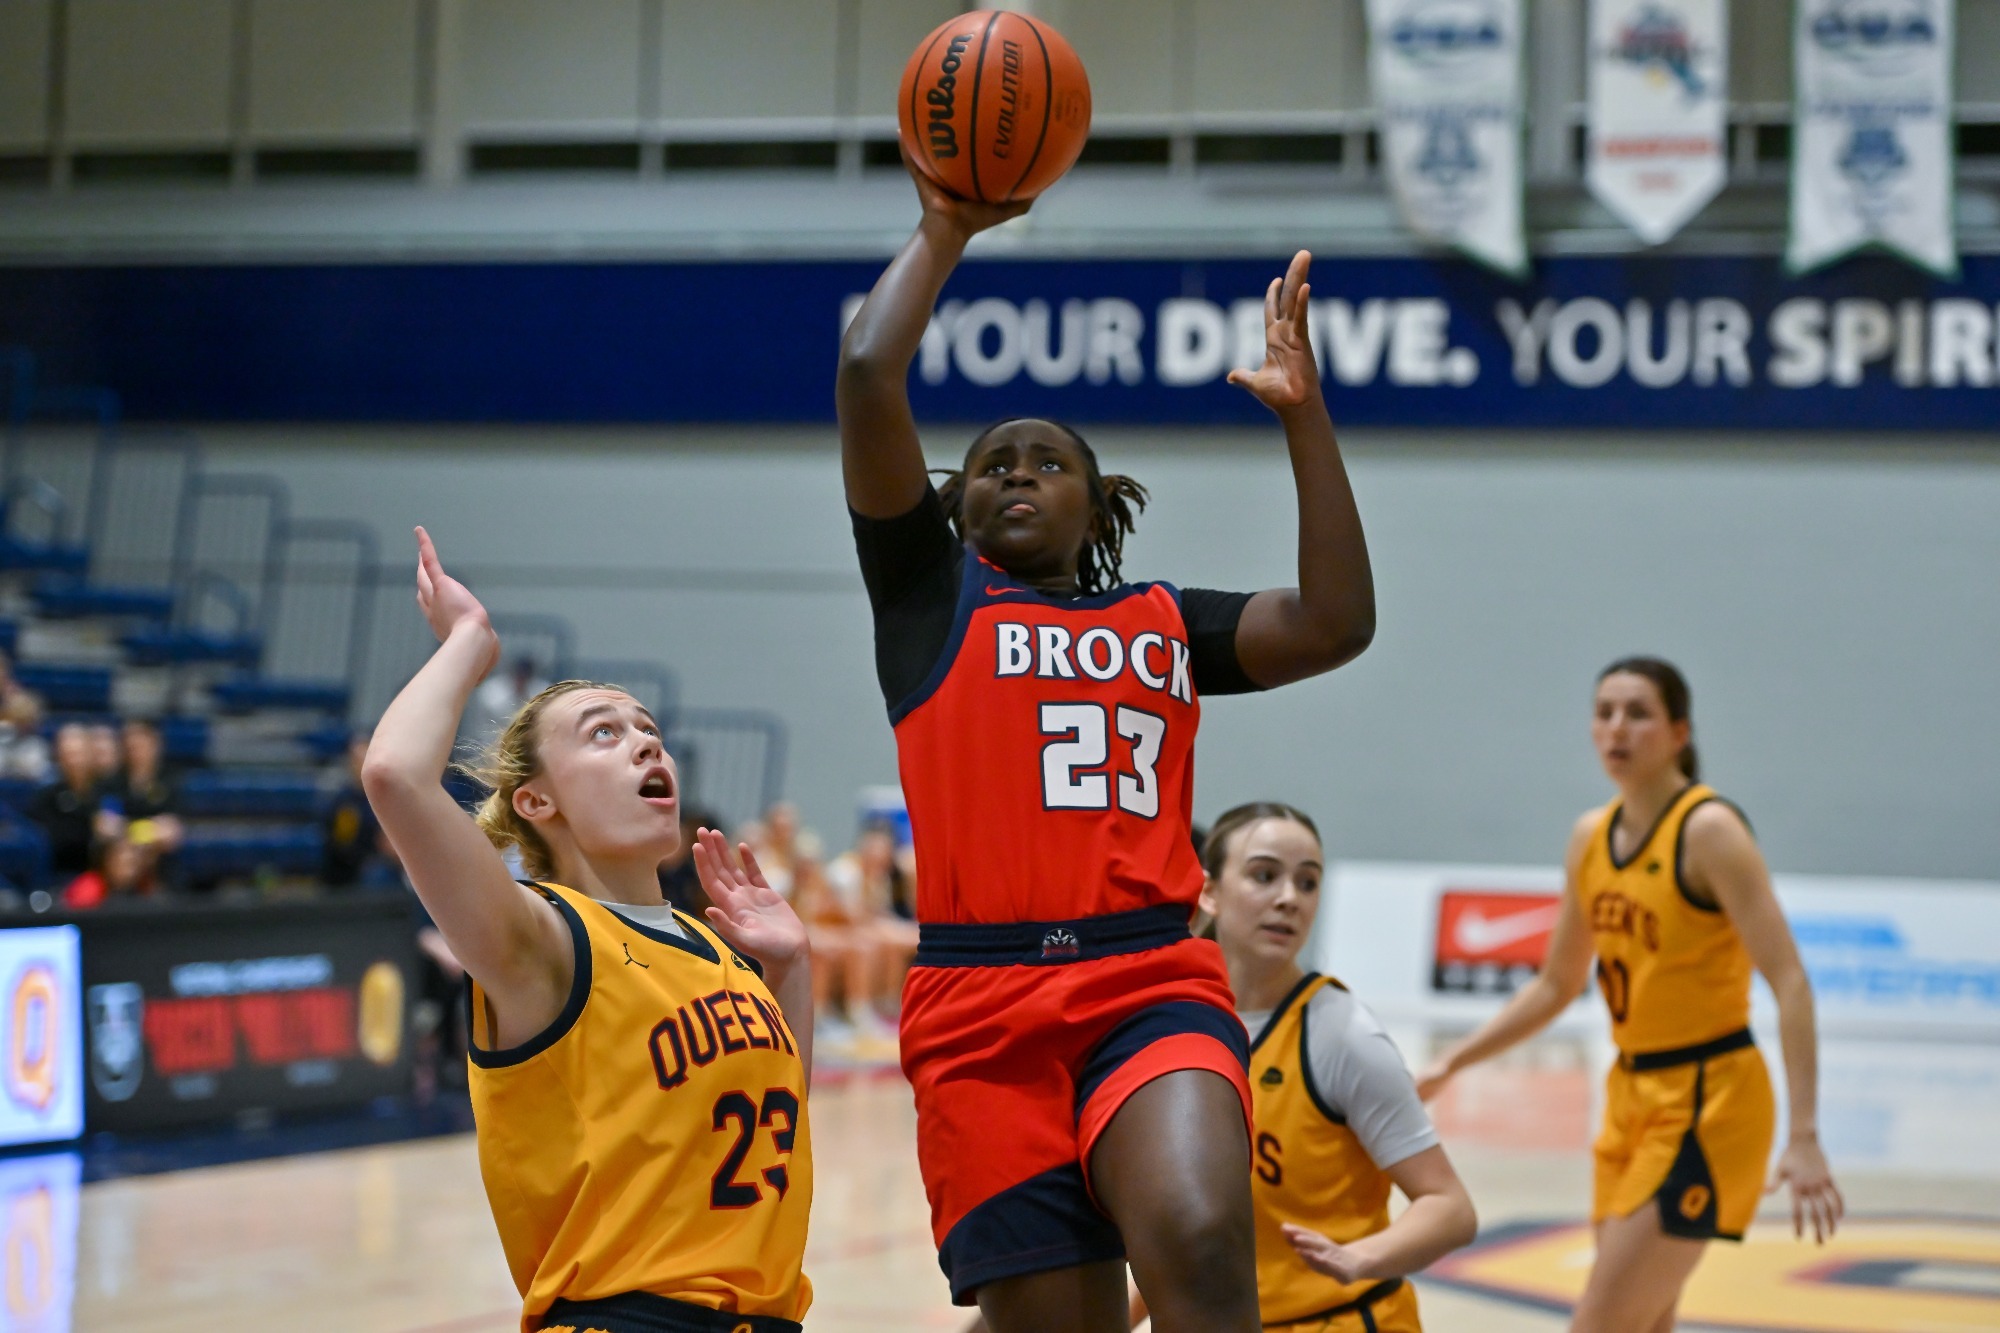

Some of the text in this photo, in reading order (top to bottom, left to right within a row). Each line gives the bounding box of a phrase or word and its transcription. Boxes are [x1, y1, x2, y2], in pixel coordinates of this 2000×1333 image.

[926, 33, 975, 160] Wilson
[919, 297, 1145, 387] YOUR
[1495, 297, 1752, 388] YOUR
[1767, 296, 2000, 388] SPIR
[995, 622, 1192, 705] BROCK
[1038, 701, 1167, 821] 23
[710, 1086, 799, 1210] 23
